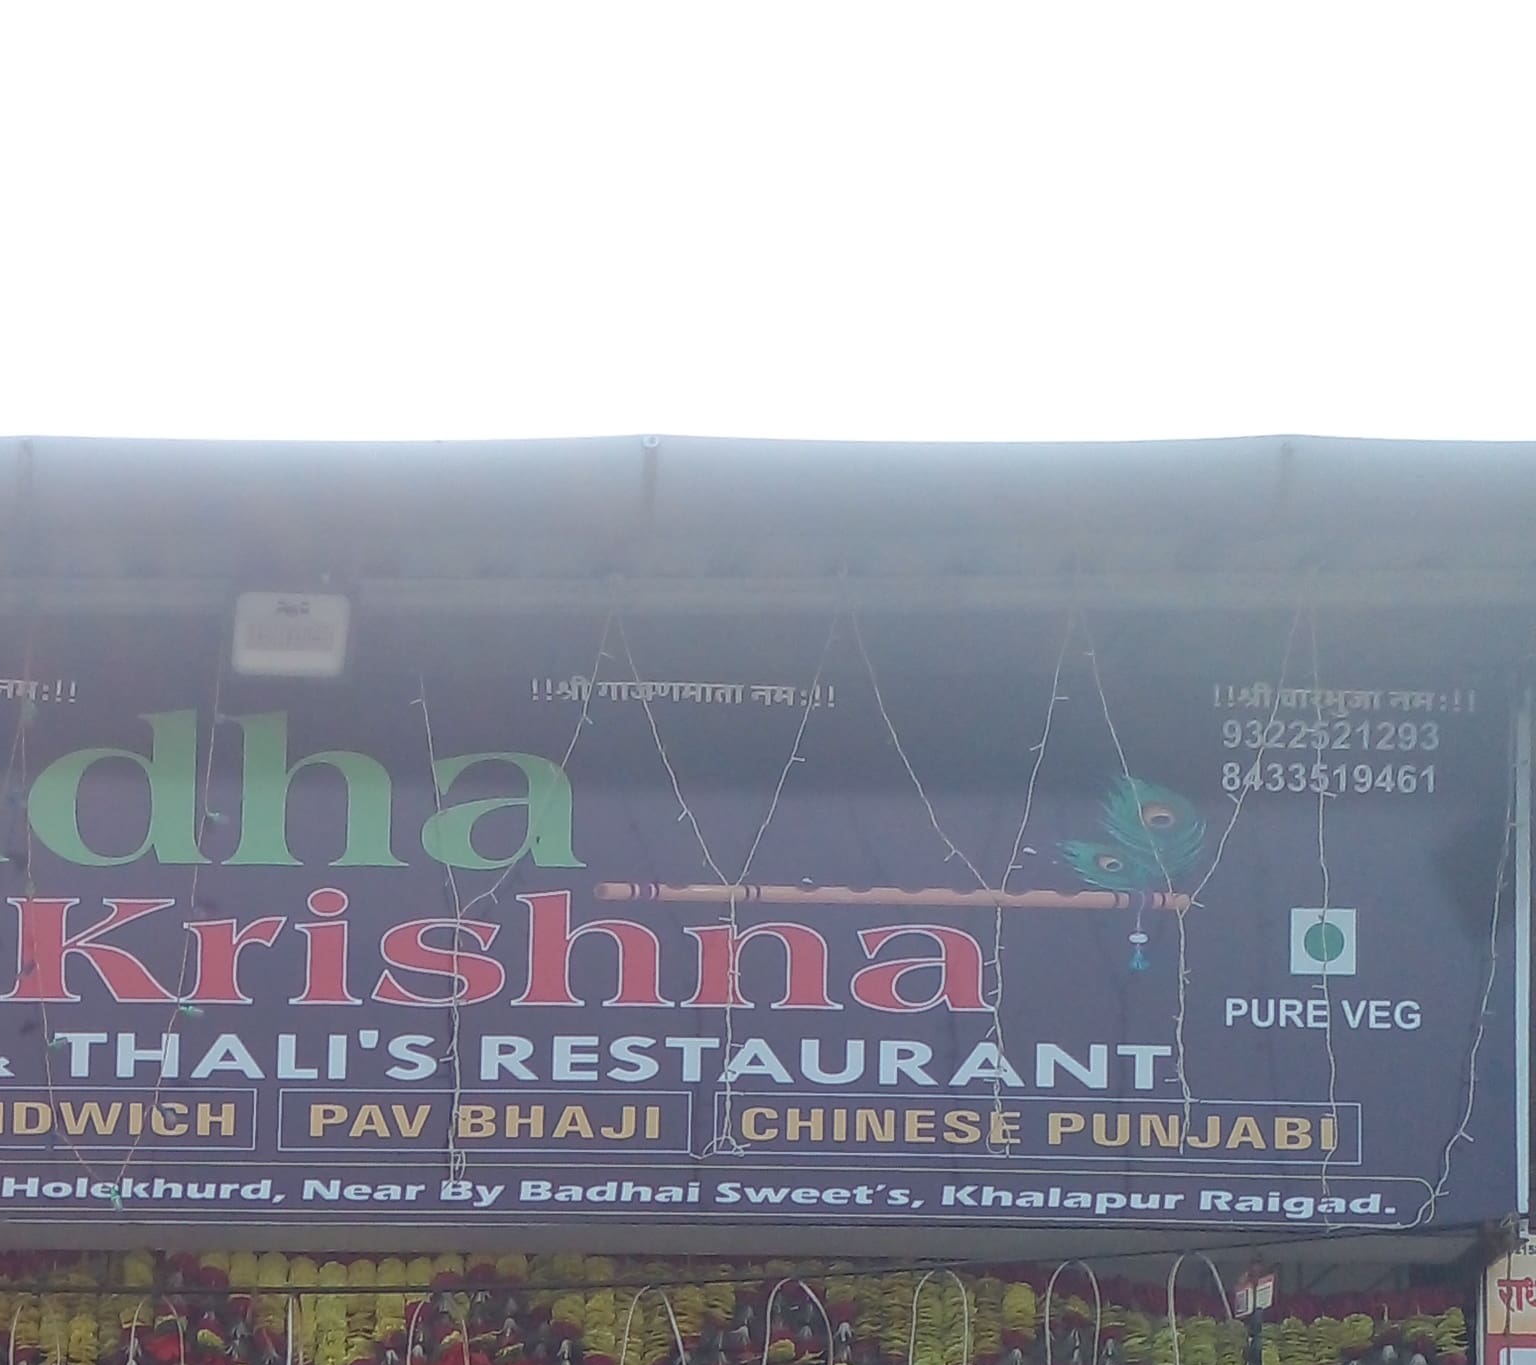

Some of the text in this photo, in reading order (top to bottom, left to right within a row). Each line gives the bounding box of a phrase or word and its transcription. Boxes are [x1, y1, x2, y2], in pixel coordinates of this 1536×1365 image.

[1222, 718, 1441, 752] 9322521293
[1221, 762, 1437, 794] 8433519461
[0, 887, 998, 1014] Krishna
[1224, 998, 1422, 1031] PURE VEG
[53, 1029, 440, 1081] THALI'S
[479, 1035, 1173, 1090] RESTAURANT
[308, 1103, 662, 1141] PAV BHAJI
[740, 1107, 1336, 1152] CHINESE PUNJABI
[0, 1175, 287, 1205] Holekhurd,
[301, 1178, 426, 1203] Near
[440, 1180, 507, 1208] By
[519, 1178, 701, 1205] Badhai
[939, 1184, 1185, 1213] Khalapur
[1197, 1188, 1397, 1219] Raigad.
